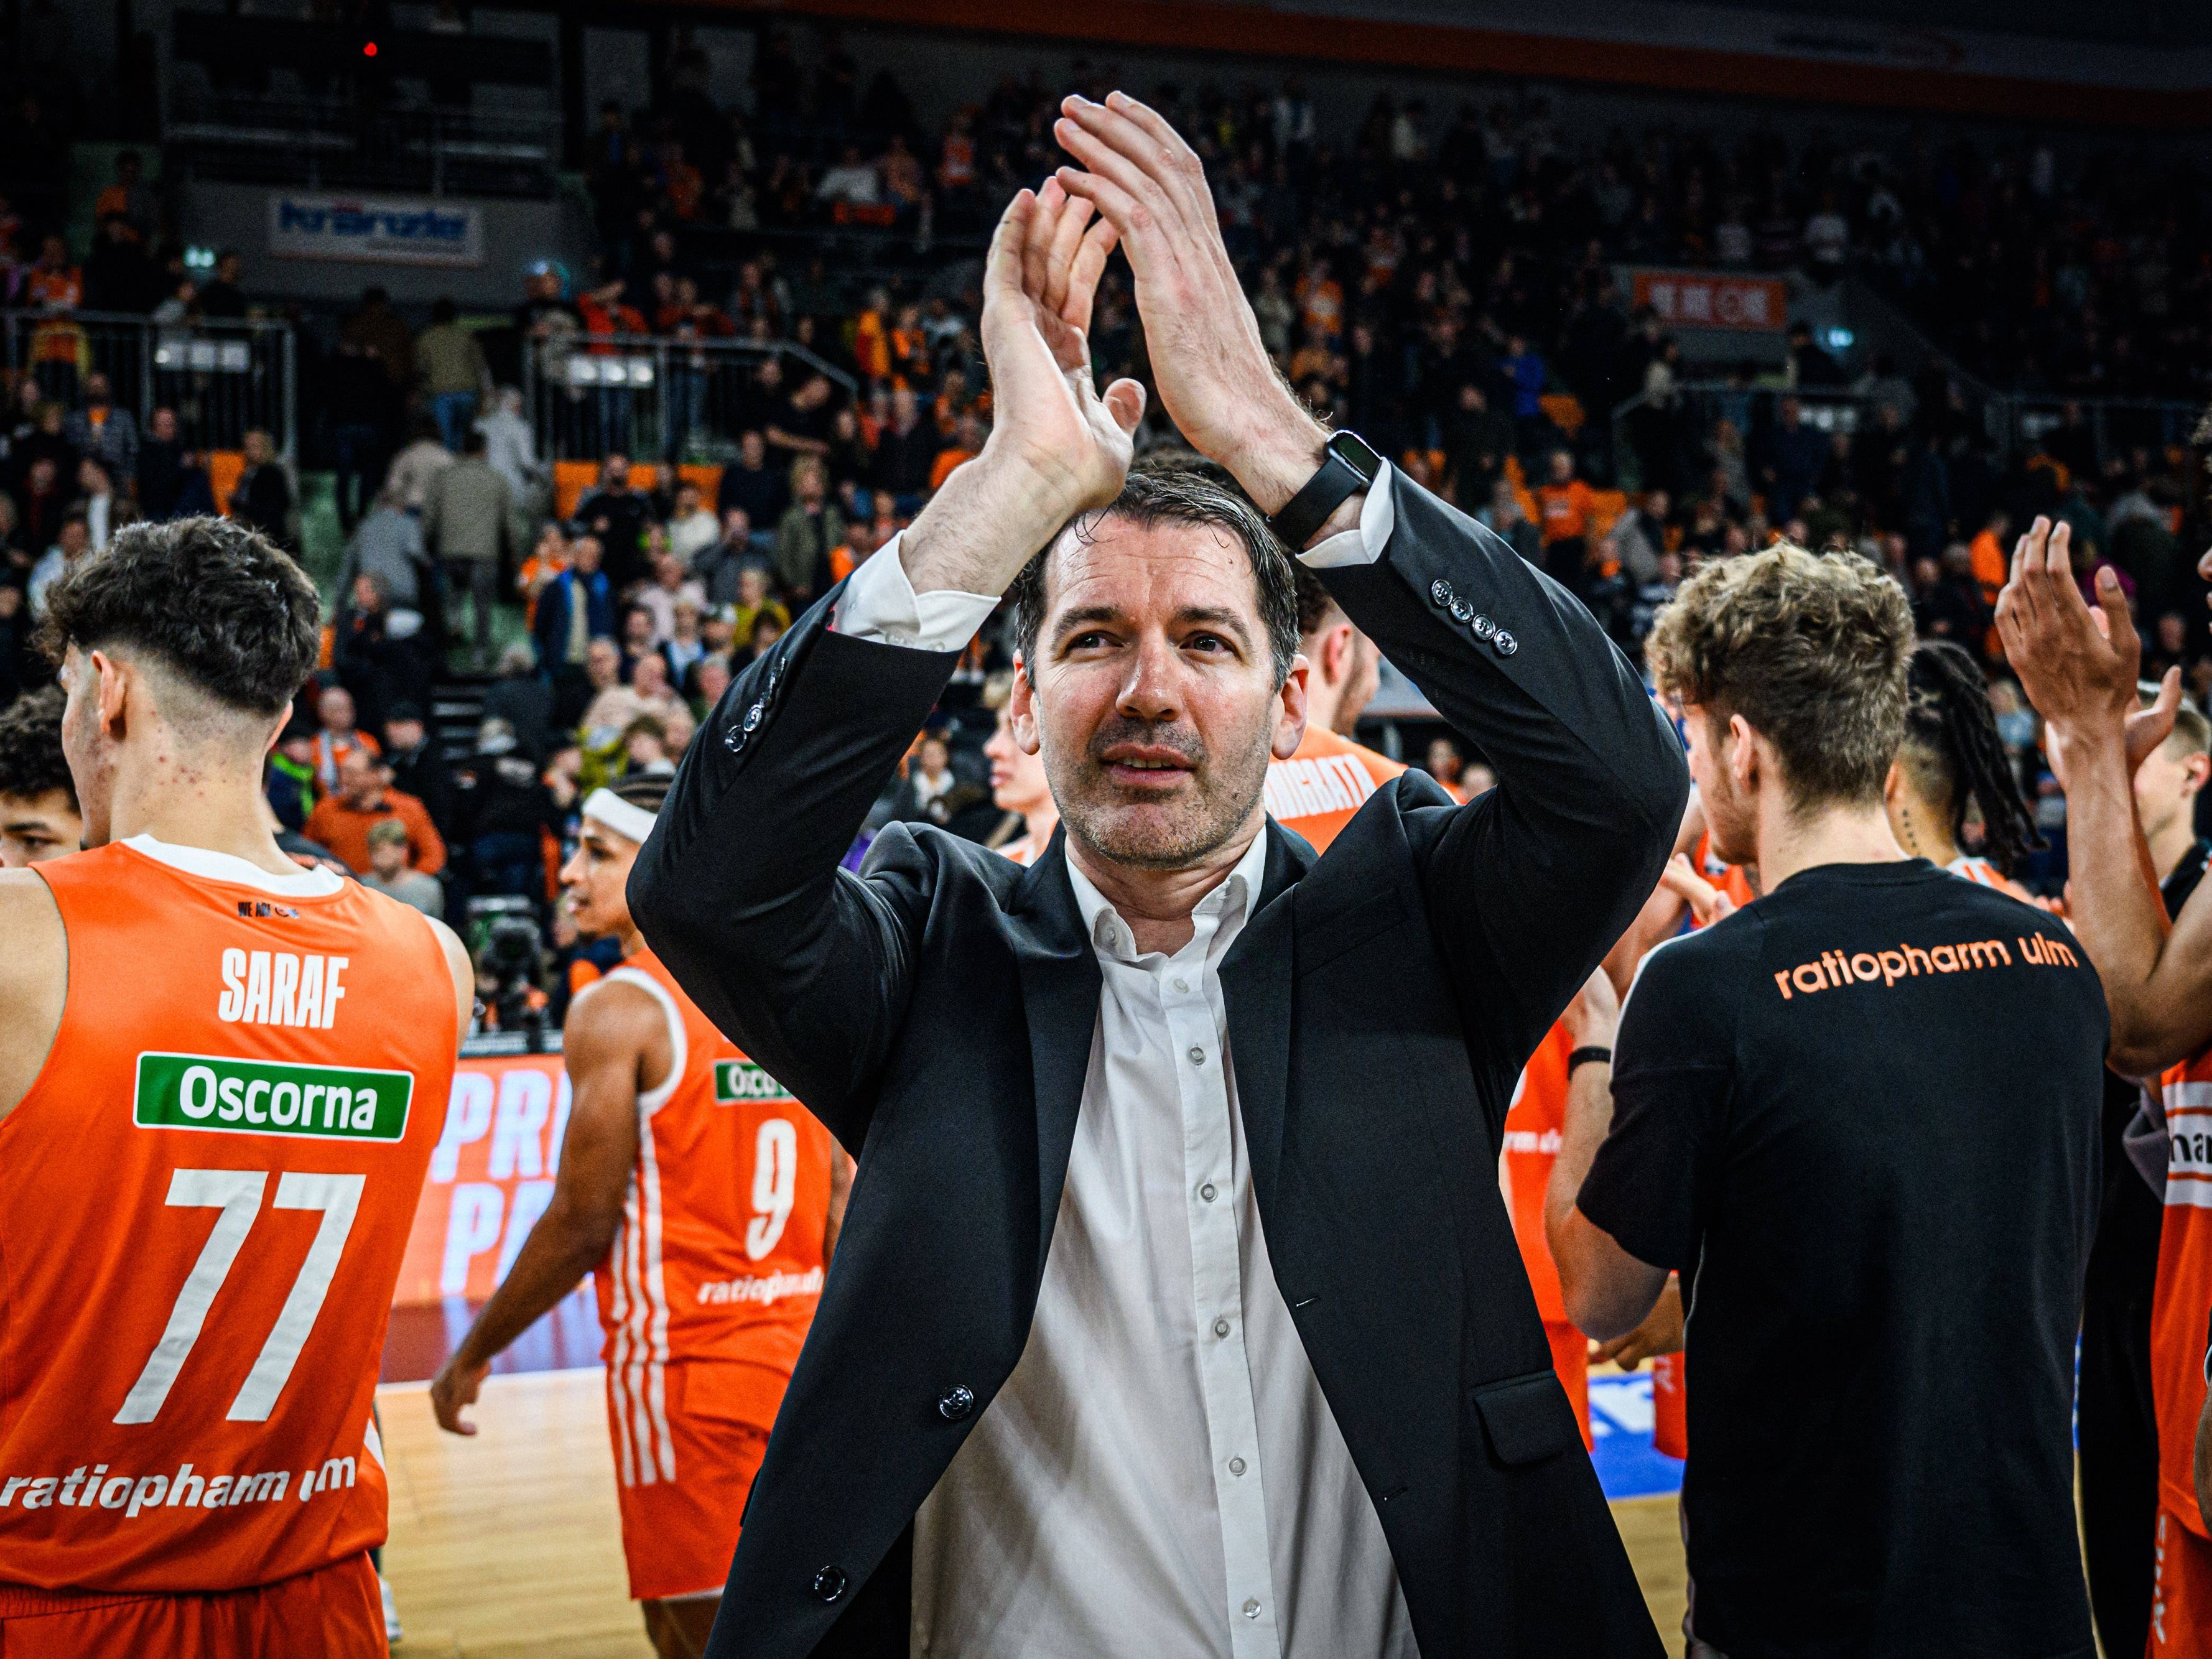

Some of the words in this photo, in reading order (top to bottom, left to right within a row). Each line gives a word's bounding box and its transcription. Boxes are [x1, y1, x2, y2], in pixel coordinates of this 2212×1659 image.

[218, 947, 350, 1029] SARAF
[1774, 939, 2012, 1000] ratiopharm
[2017, 932, 2079, 969] ulm
[180, 1065, 378, 1130] Oscorna
[746, 1118, 797, 1261] 9
[113, 1168, 366, 1424] 77
[0, 1464, 290, 1518] ratiopharm
